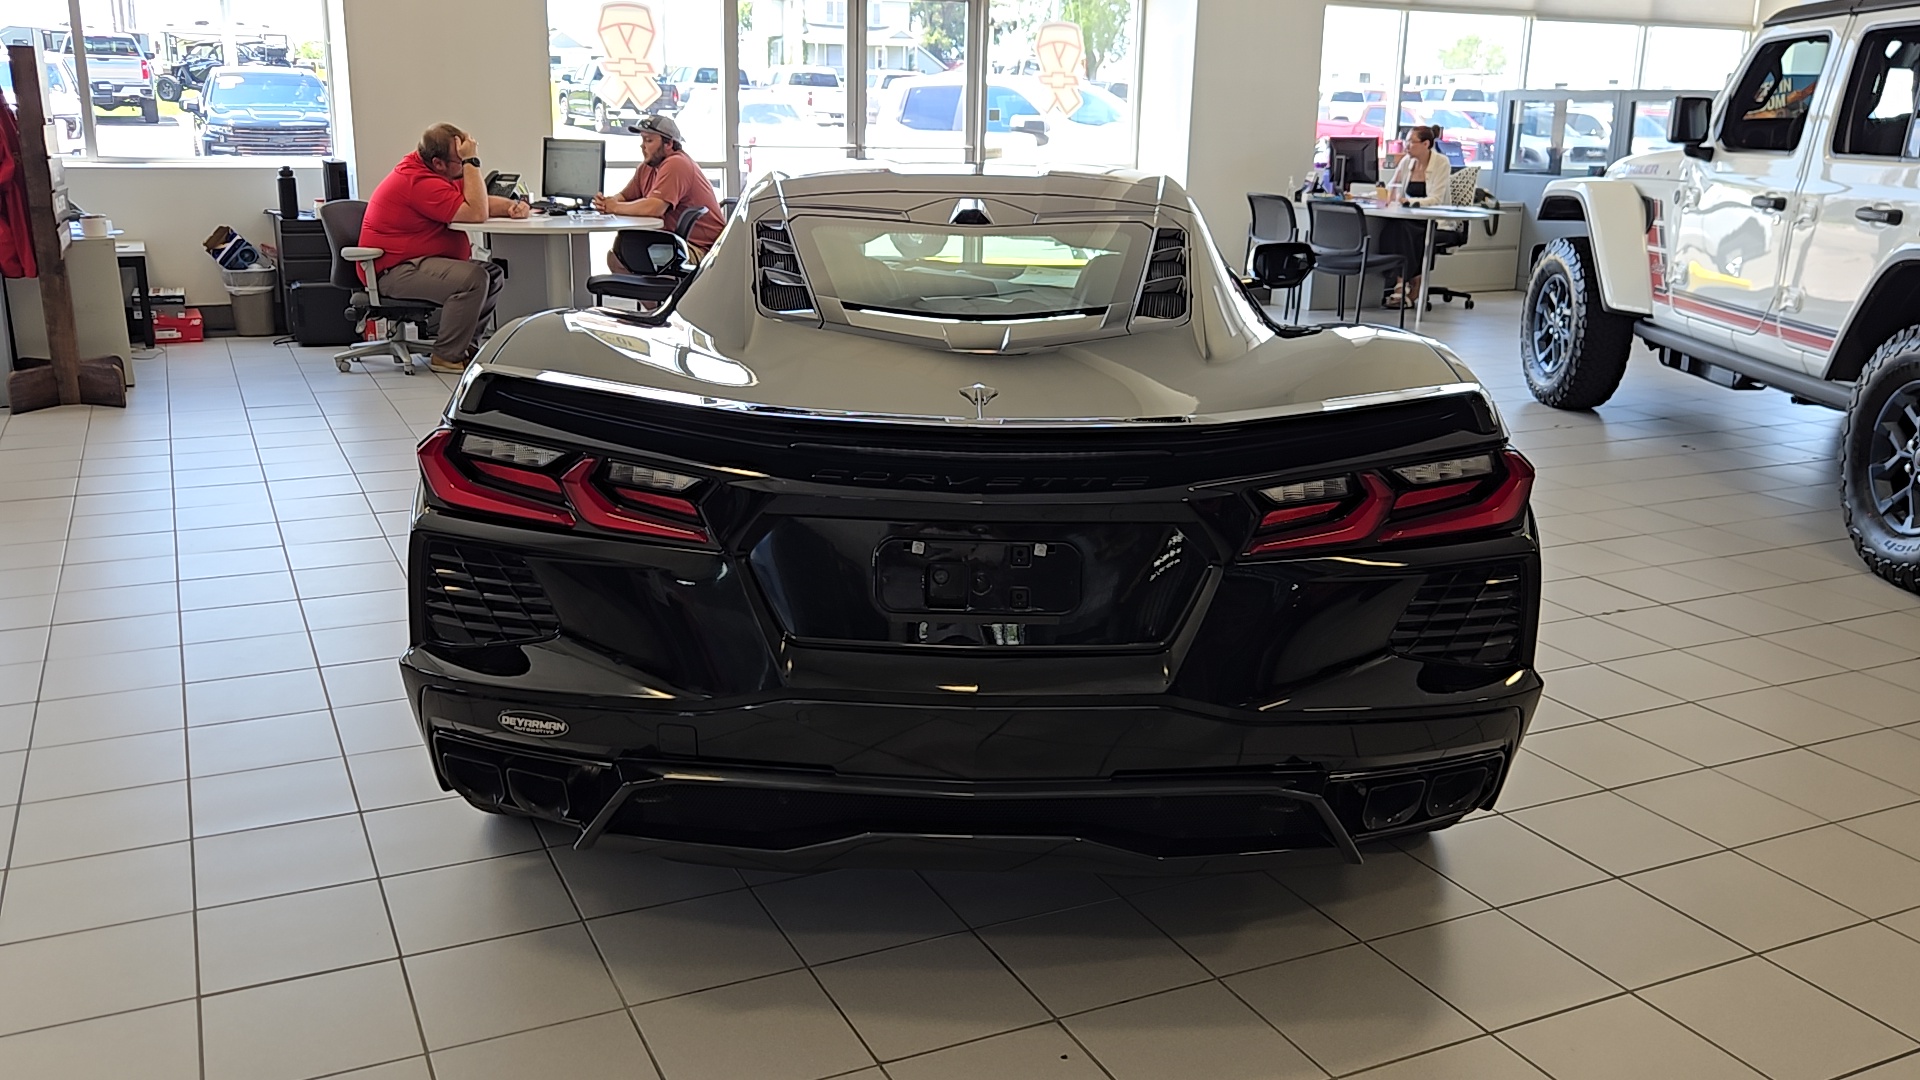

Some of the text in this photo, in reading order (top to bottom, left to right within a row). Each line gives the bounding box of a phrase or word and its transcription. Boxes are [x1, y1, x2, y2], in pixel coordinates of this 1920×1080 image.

[811, 468, 1150, 487] CORVETTE
[501, 715, 566, 732] DEYARMAN
[513, 725, 555, 735] AUTOMOTIVE
